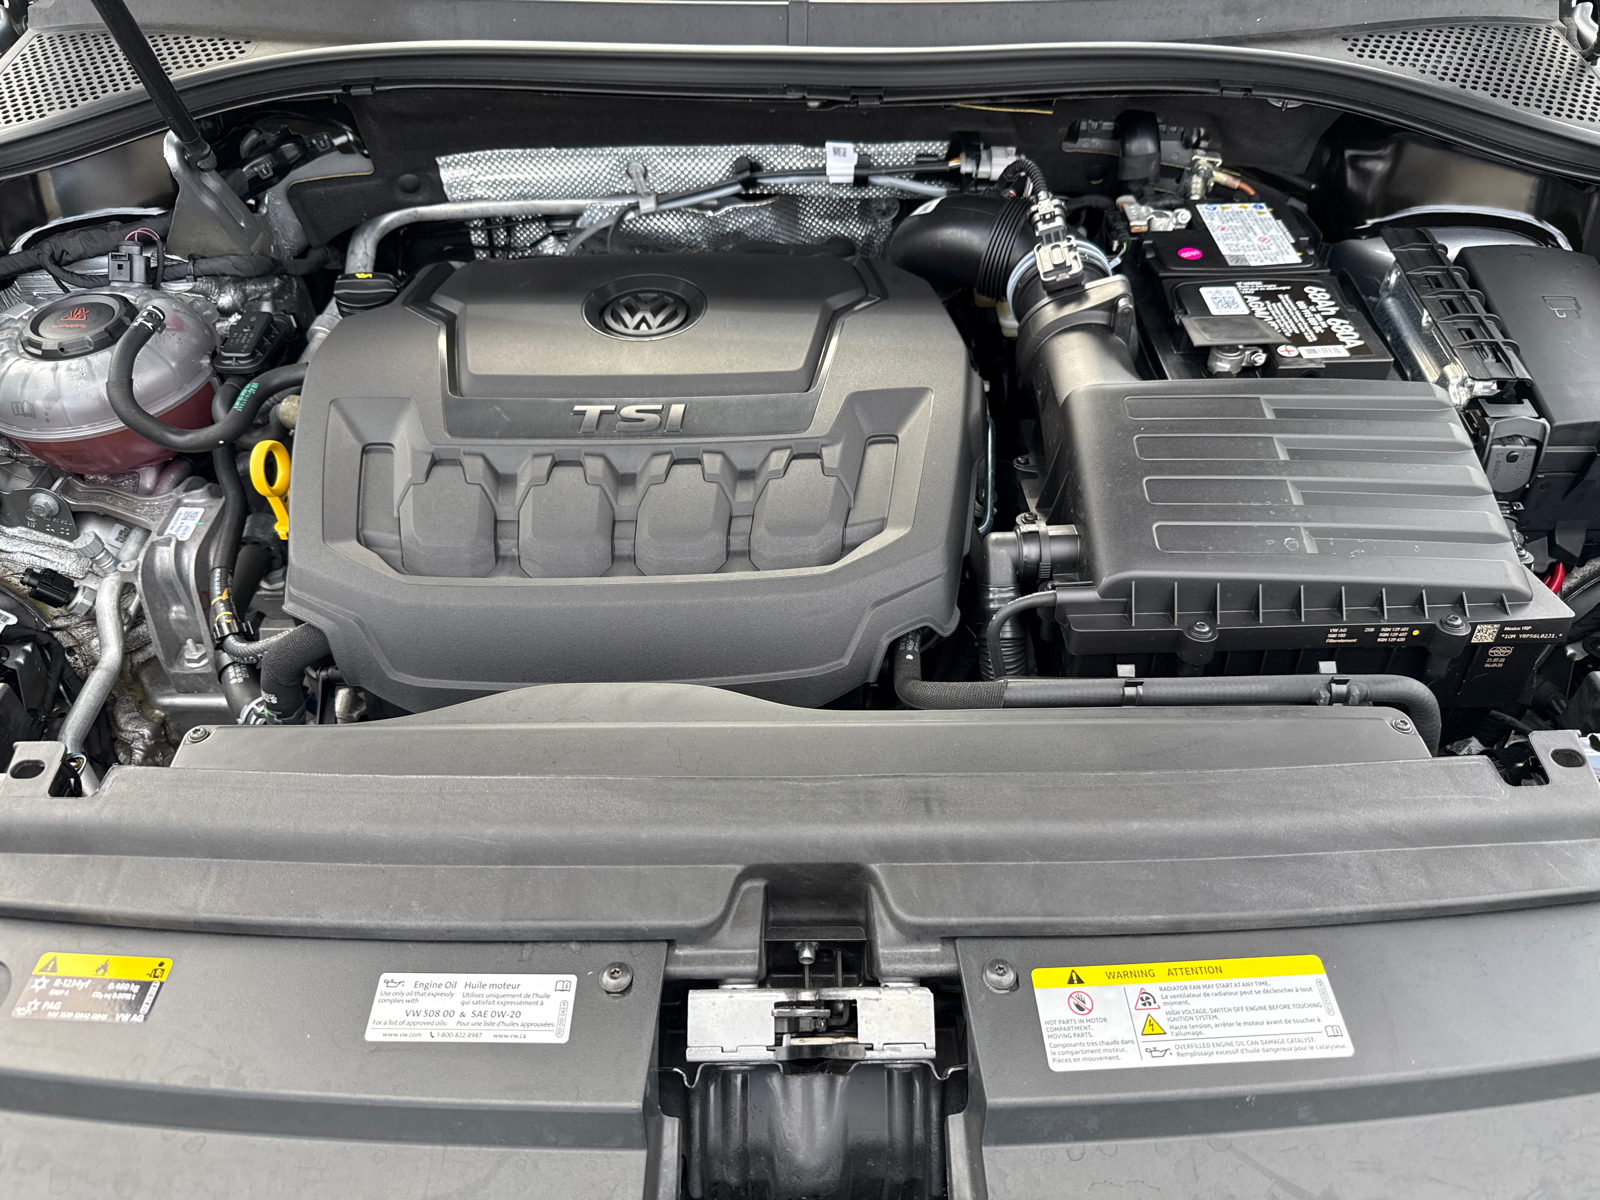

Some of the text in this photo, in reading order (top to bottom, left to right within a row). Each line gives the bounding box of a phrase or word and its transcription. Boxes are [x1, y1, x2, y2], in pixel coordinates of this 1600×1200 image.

[603, 292, 688, 337] VW
[1303, 285, 1340, 316] 68Ah
[1326, 317, 1365, 349] 680A
[570, 403, 688, 433] TSI
[1105, 965, 1223, 980] WARNING ATTENTION
[53, 978, 92, 991] R-1234yf
[414, 981, 457, 990] Engine Oil
[464, 981, 521, 989] Huile moteur
[392, 990, 405, 998] only
[427, 991, 455, 999] expressly
[1240, 988, 1253, 996] peut
[41, 1001, 62, 1011] PAG
[115, 1013, 130, 1022] VW
[130, 1014, 144, 1023] AG
[423, 1010, 440, 1018] 508
[443, 1010, 455, 1018] 00
[471, 1010, 489, 1018] SAE
[490, 1010, 521, 1019] 0W-20
[1046, 1025, 1094, 1033] COMPARTMENT.
[1049, 1041, 1085, 1049] Composants
[1058, 1048, 1101, 1056] compartiment
[1177, 1050, 1214, 1058] Remplissage
[1262, 1045, 1292, 1053] dangereux
[1315, 1043, 1348, 1051] catalyseur.
